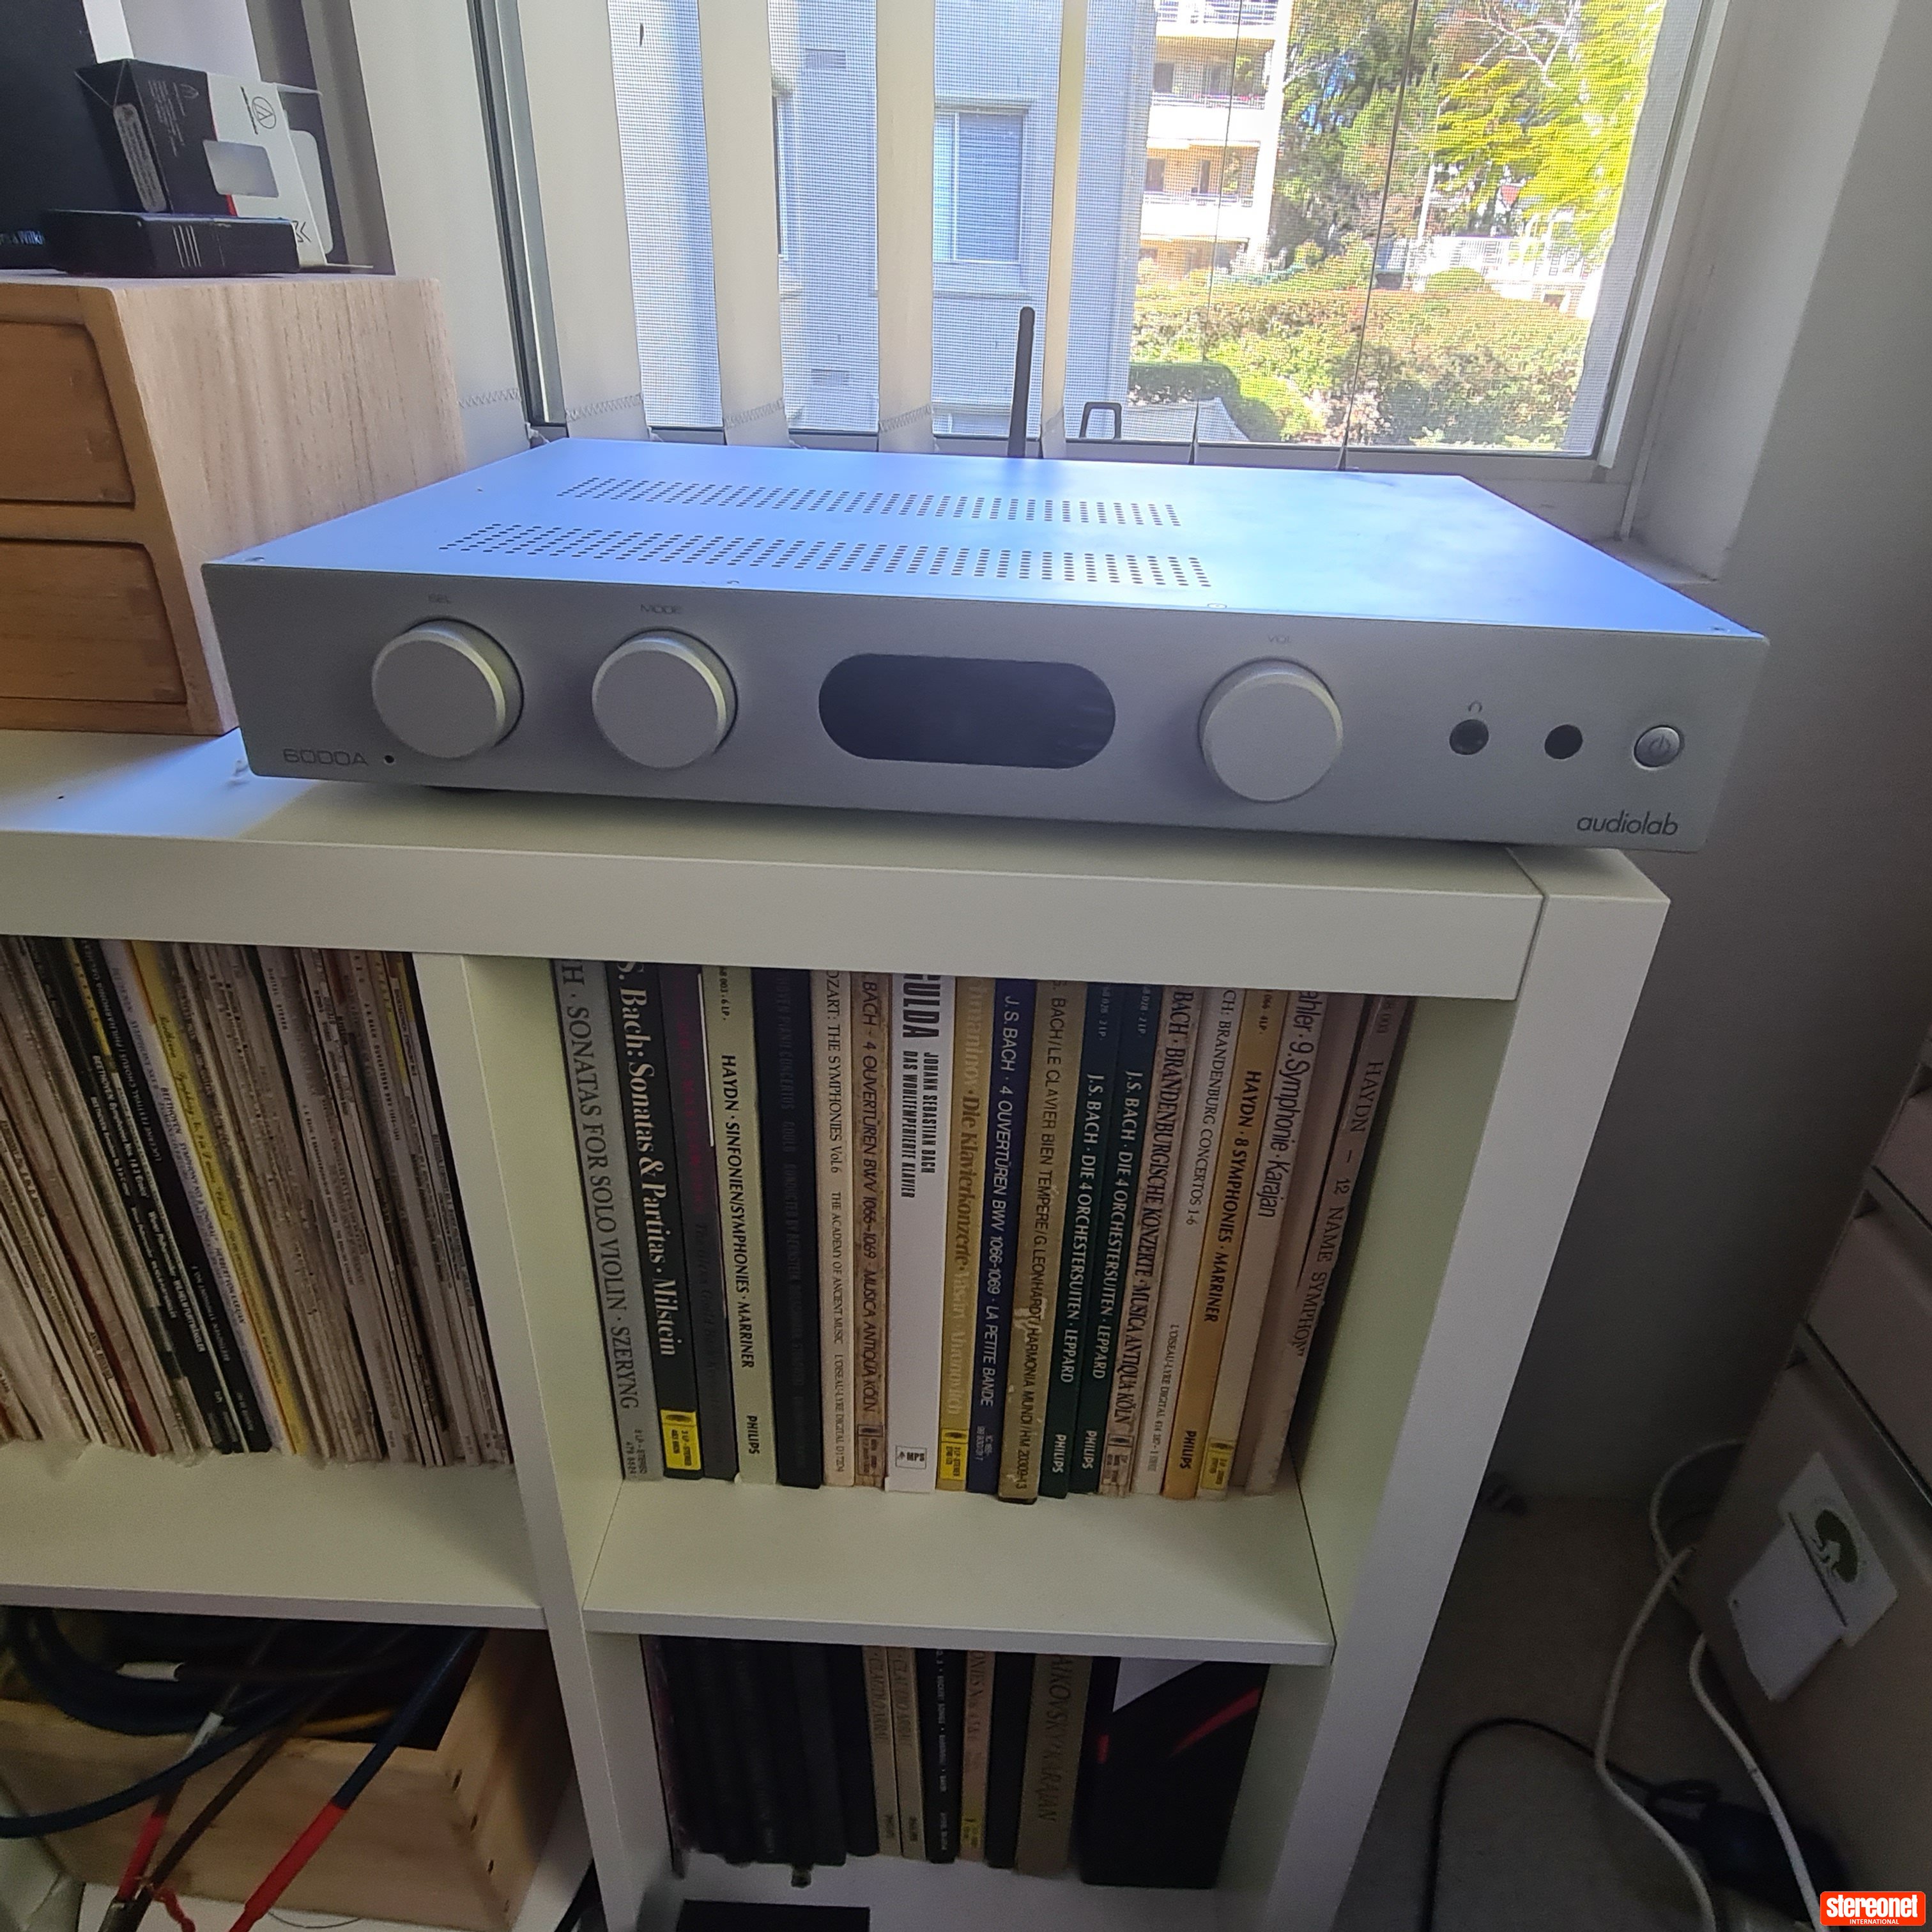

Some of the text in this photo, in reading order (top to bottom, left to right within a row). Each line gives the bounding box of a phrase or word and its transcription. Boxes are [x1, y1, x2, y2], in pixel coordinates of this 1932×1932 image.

[640, 604, 682, 614] MODE
[283, 749, 368, 765] 6000A
[1577, 810, 1678, 836] audiolab
[618, 988, 655, 1057] Bach:
[827, 1024, 840, 1052] THE
[1167, 991, 1195, 1036] BACH
[567, 1006, 602, 1116] SONATAS
[999, 1027, 1018, 1071] BACH
[627, 1061, 664, 1152] Sonatas
[721, 1054, 739, 1111] HAYDN
[827, 1055, 841, 1142] SYMPHONIES
[999, 1085, 1013, 1094] 4
[1041, 1068, 1060, 1130] CLAVIER
[1185, 990, 1237, 1226] CH: BRANDENBURG CONCERTOS 1-6
[900, 1050, 918, 1199] DAS WOHLTEMPERIERTE KLAVIER
[921, 1052, 939, 1174] JOHANN SEBASTIAN BACH
[961, 1095, 980, 1128] Die
[1082, 1100, 1102, 1143] BACH
[1119, 1097, 1140, 1140] BACH
[1141, 1047, 1186, 1204] BRANDENBURGISCHE
[582, 1123, 608, 1169] FOR
[638, 1156, 665, 1177] &
[992, 1100, 1015, 1195] OUVERTÜREN
[1039, 1133, 1054, 1165] BIEN
[1078, 1154, 1096, 1179] DIE
[1116, 1151, 1133, 1176] DIE
[590, 1176, 617, 1233] SOLO
[724, 1121, 750, 1293] SINFONIEN/SYMPHONIES
[861, 981, 879, 1413] BACH 4 OUVERTÜREN BWV 1066-1069 MUSICA ANTIQUA KÖLN
[954, 1131, 979, 1265] Klavierkonzerte
[1078, 1181, 1092, 1190] 4
[1116, 1178, 1130, 1186] 4
[1203, 1070, 1261, 1322] HAYDN 8 SYMPHONIES MARRINER
[1251, 1159, 1291, 1218] Karajan
[1285, 1061, 1384, 1356] HAYDN 12 NAME SYMPHON
[641, 1182, 674, 1264] Partitas
[990, 1199, 1006, 1230] BWV
[832, 1191, 843, 1344] THE ACADEMY OF ANCIENT MUSIC
[986, 1235, 1003, 1294] 1066-1069
[1065, 1193, 1092, 1319] ORCHESTERSUITEN
[1098, 1190, 1128, 1316] ORCHESTERSUITEN
[1133, 1207, 1163, 1277] KONZERTE
[597, 1238, 627, 1310] VIOLIN
[652, 1278, 683, 1356] Milstein
[737, 1301, 754, 1368] MARRINER
[985, 1305, 999, 1319] LA
[1126, 1284, 1151, 1331] MUSICA
[609, 1326, 640, 1409] SZERYNG
[983, 1324, 997, 1365] PETITE
[1059, 1329, 1078, 1383] LEPPARD
[1092, 1324, 1111, 1379] LEPPARD
[1115, 1334, 1144, 1388] ANTIQUA
[981, 1366, 995, 1406] BANDE
[1113, 1392, 1137, 1423] KÖLN
[1156, 1386, 1169, 1418] DIGITAL
[746, 1414, 759, 1455] PHILIPS
[835, 1414, 844, 1444] DIGITAL
[1051, 1433, 1066, 1473] PHILIPS
[1082, 1429, 1098, 1469] PHILIPS
[1179, 1429, 1197, 1469] PHILIPS
[907, 1452, 924, 1462] MPS
